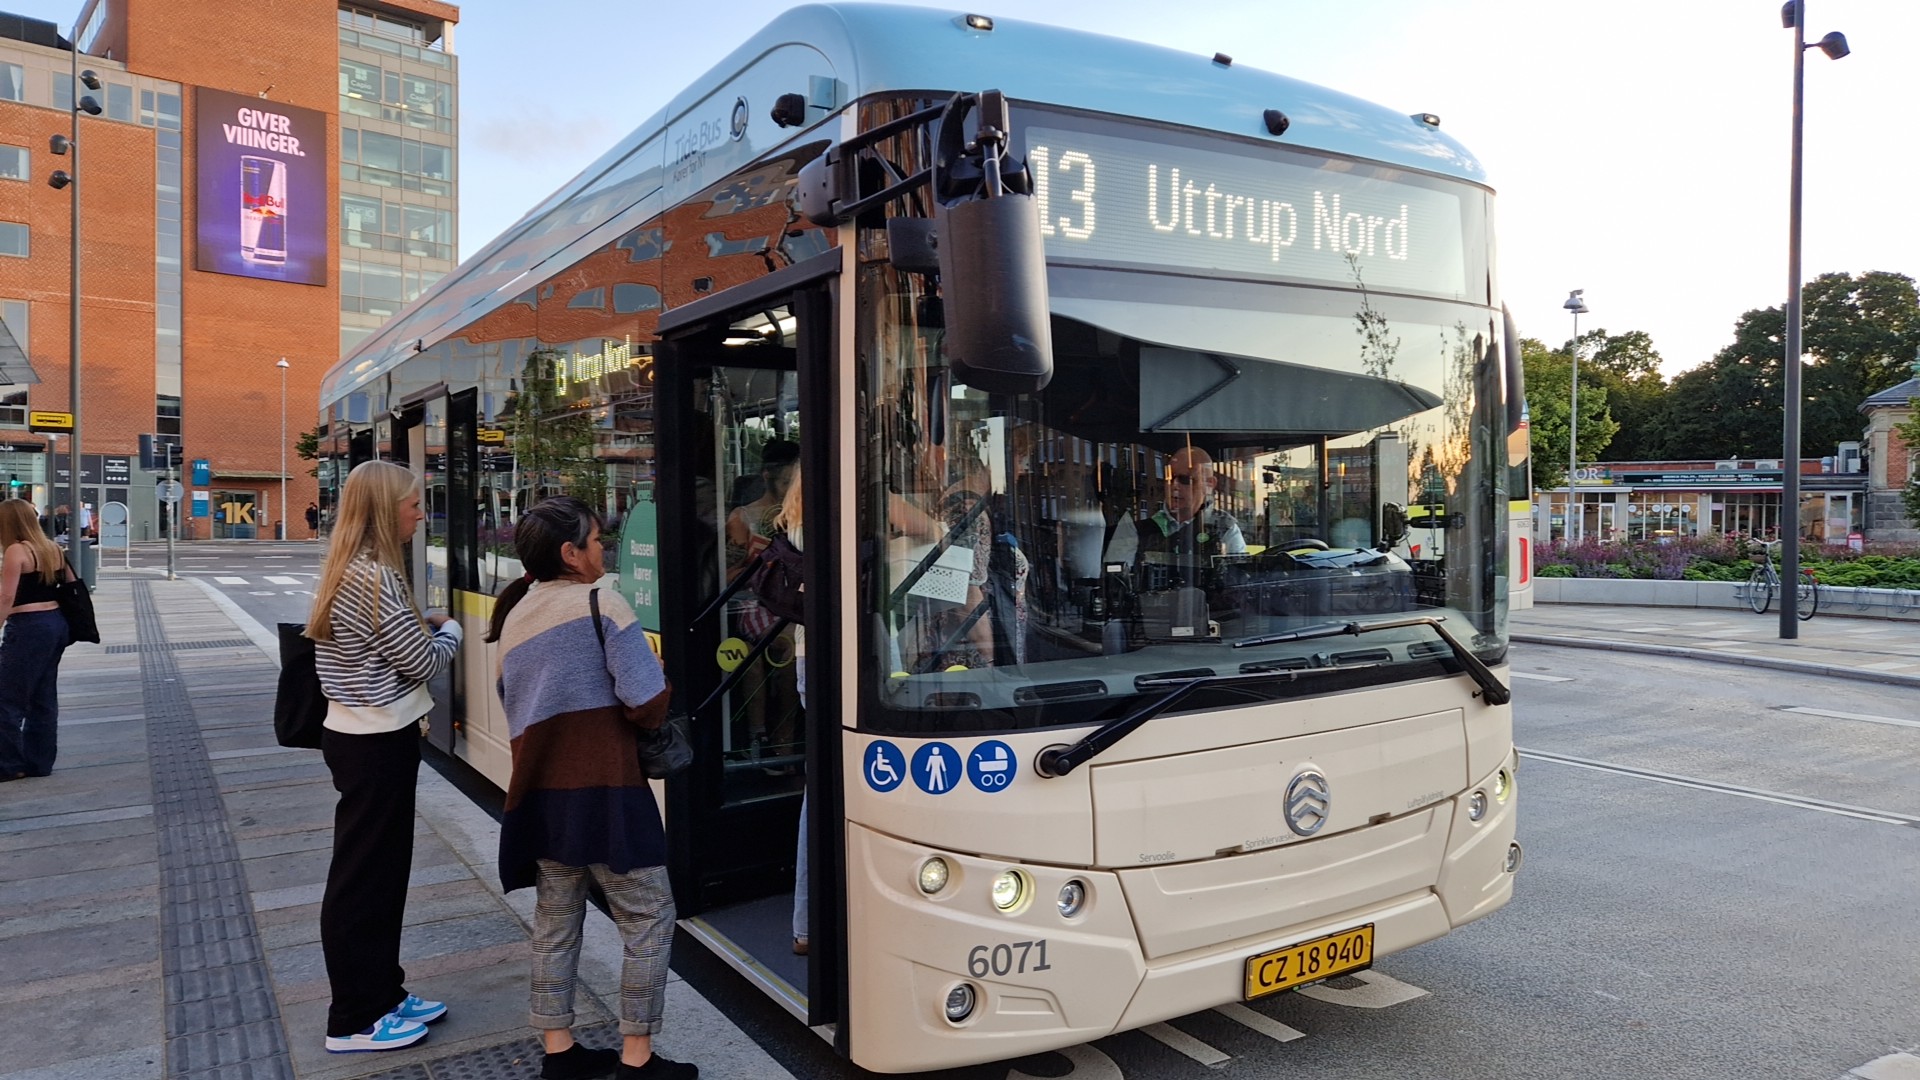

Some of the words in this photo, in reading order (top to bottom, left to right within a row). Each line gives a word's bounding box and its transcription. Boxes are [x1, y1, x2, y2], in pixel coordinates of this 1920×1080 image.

[238, 107, 291, 135] GIVER
[222, 123, 306, 157] VIIINGER.
[675, 129, 698, 165] Tide
[699, 118, 722, 150] Bus
[1030, 145, 1096, 239] 13
[1149, 164, 1298, 262] Uttrup
[1314, 190, 1408, 261] Nord
[220, 502, 255, 524] 1K
[630, 540, 655, 557] Bussen
[633, 563, 653, 581] kører
[635, 587, 644, 607] på
[644, 589, 653, 606] el
[1138, 850, 1176, 863] Servoolie
[967, 938, 1052, 979] 6071
[1258, 955, 1289, 987] CZ
[1296, 946, 1321, 978] 18
[1326, 934, 1364, 969] 940
